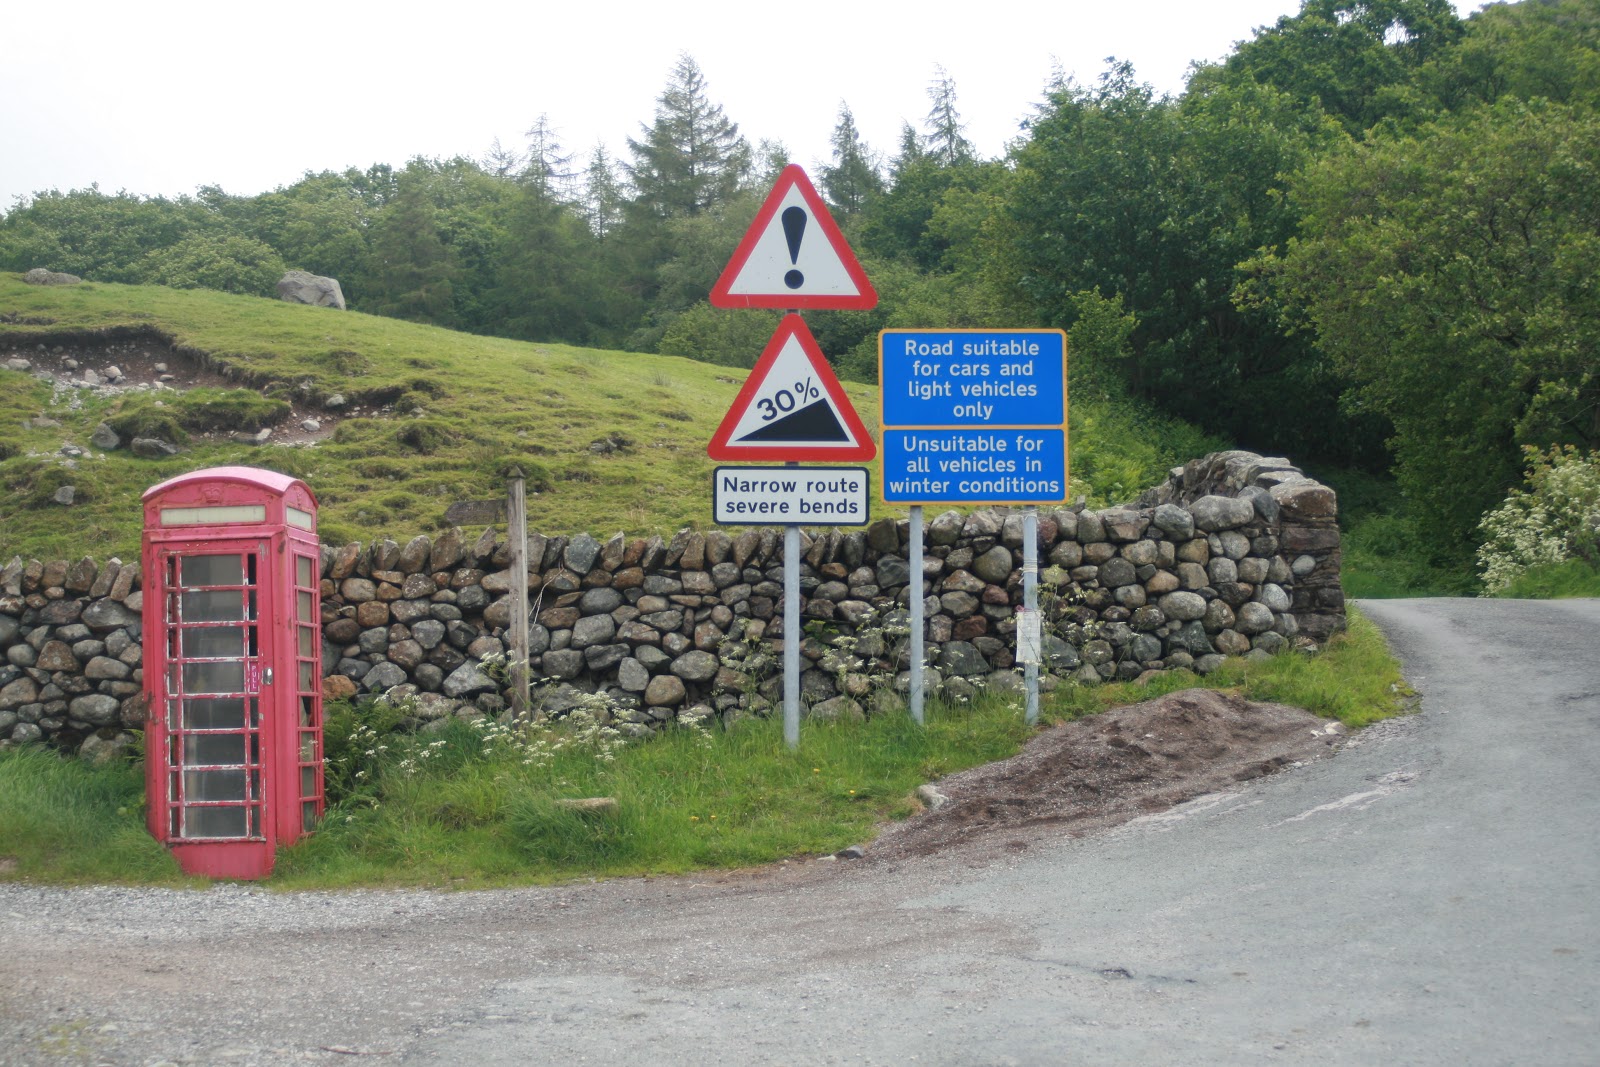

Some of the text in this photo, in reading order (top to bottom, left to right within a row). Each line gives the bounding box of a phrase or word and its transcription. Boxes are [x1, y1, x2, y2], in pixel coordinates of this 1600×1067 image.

[905, 339, 1040, 356] Road suitable
[912, 360, 1033, 376] for cars and
[908, 380, 1037, 400] light vehicles
[757, 377, 820, 421] 30%
[953, 401, 993, 420] only
[903, 435, 1044, 452] Unsuitable for
[906, 456, 1042, 473] all vehicles in
[723, 476, 859, 493] Narrow route
[889, 477, 1059, 493] winter conditions
[725, 498, 858, 514] severe bends
